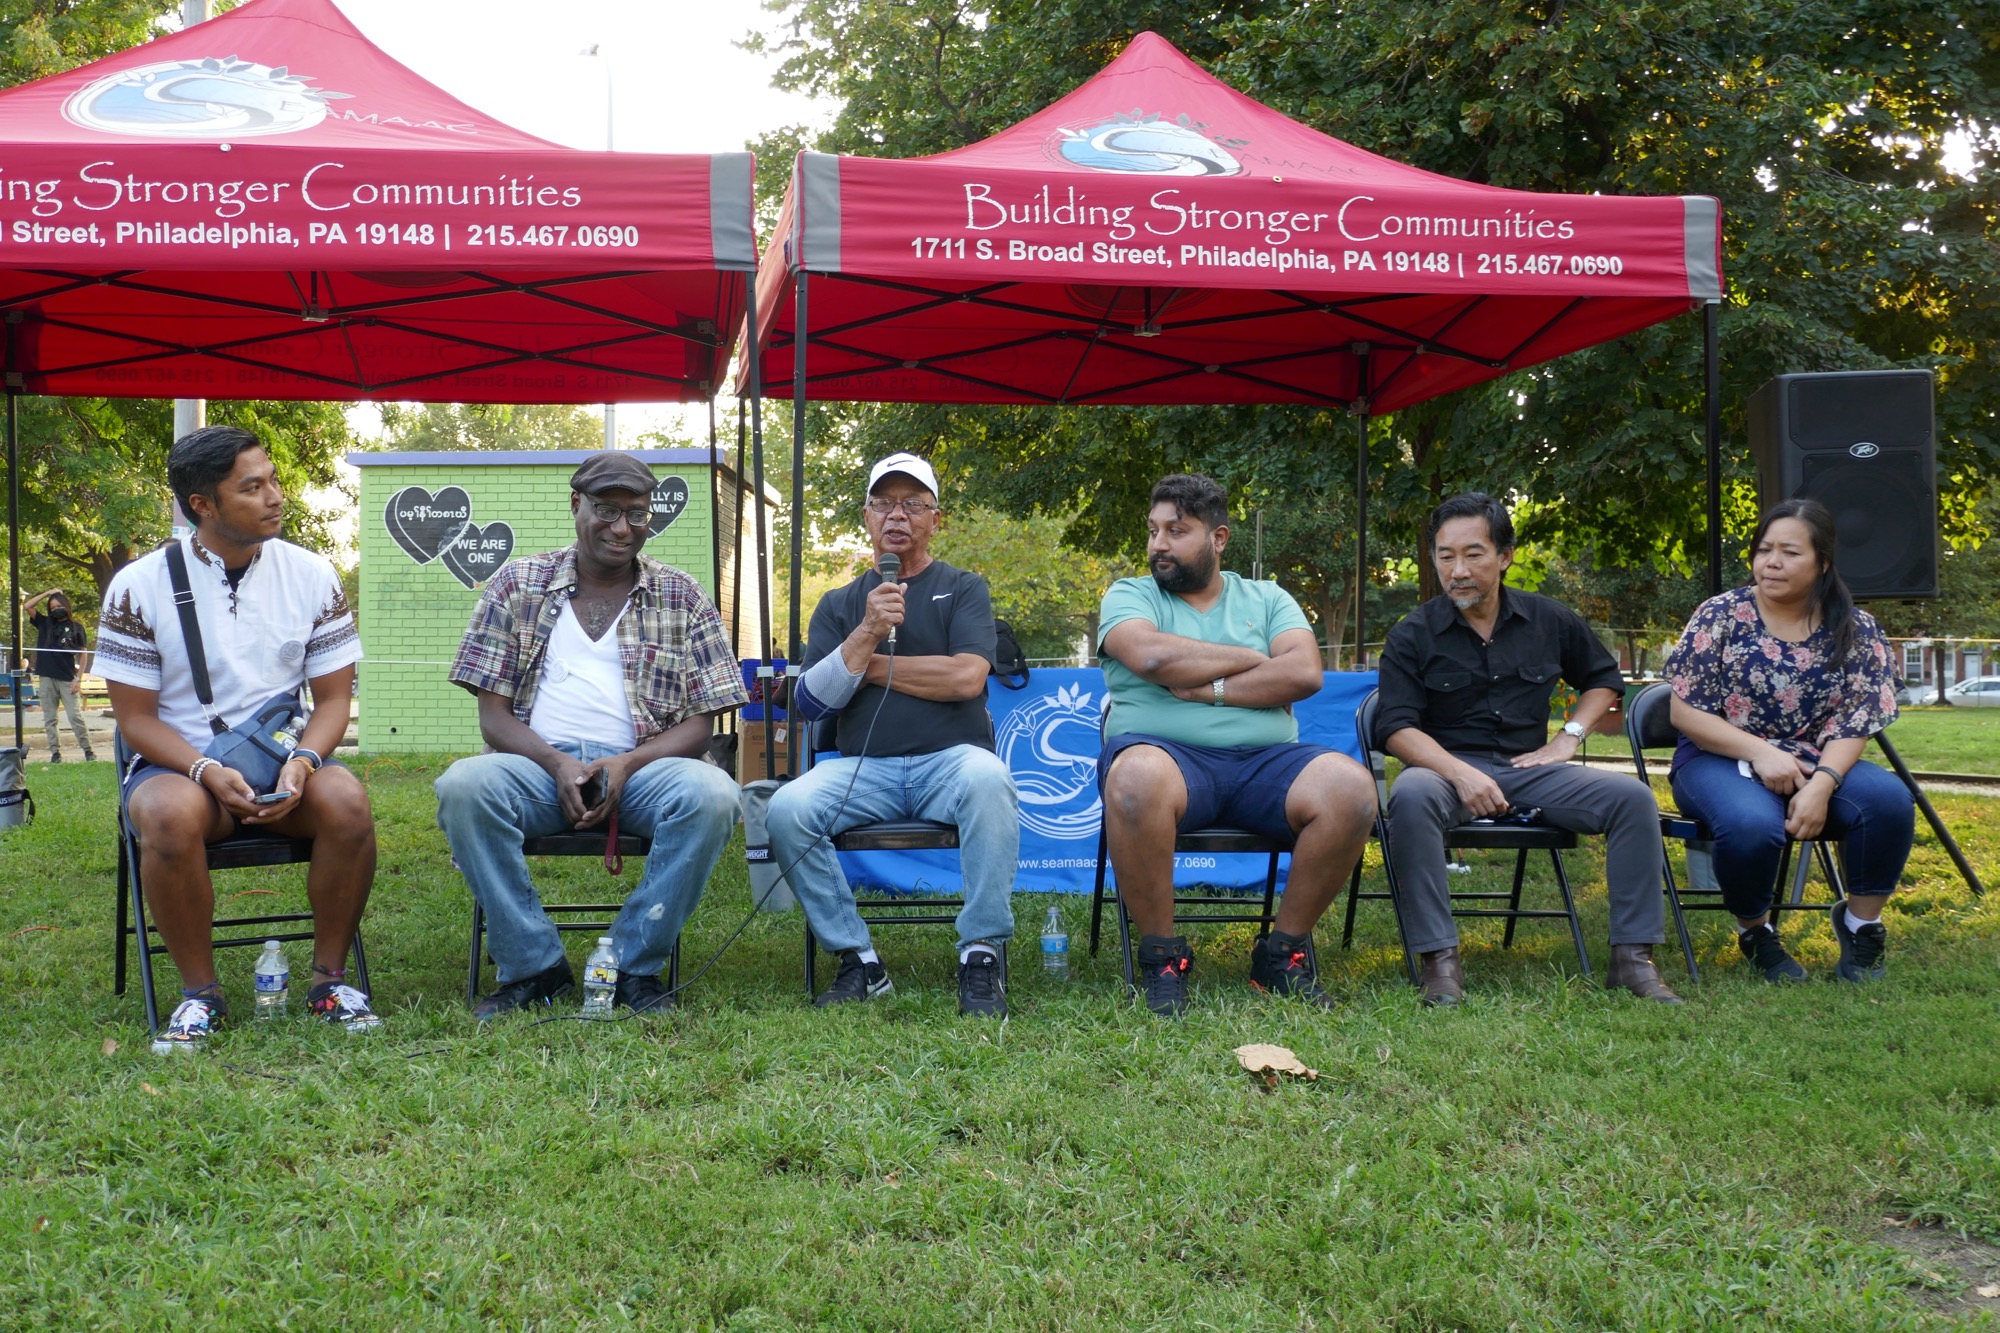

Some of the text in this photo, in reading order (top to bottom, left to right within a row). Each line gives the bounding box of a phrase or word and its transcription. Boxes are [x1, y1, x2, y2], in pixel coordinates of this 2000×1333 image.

[0, 161, 582, 219] ing Stronger Communities
[963, 182, 1575, 246] Building Stronger Communities
[12, 220, 106, 248] Street,
[116, 222, 300, 249] Philadelphia,
[309, 223, 348, 245] PA
[355, 223, 435, 246] 19148
[467, 224, 640, 247] 215.467.0690
[911, 236, 967, 260] 1711
[975, 238, 1000, 261] S.
[1008, 239, 1085, 263] Broad
[1092, 242, 1172, 268] Street,
[1180, 244, 1336, 275] Philadelphia,
[1343, 250, 1377, 271] PA
[1382, 251, 1451, 273] 19148
[1477, 253, 1624, 276] 215.467.0690
[651, 491, 685, 501] LLY IS
[648, 503, 678, 513] AMILY
[457, 539, 507, 550] WE ARE
[468, 552, 495, 564] ONE
